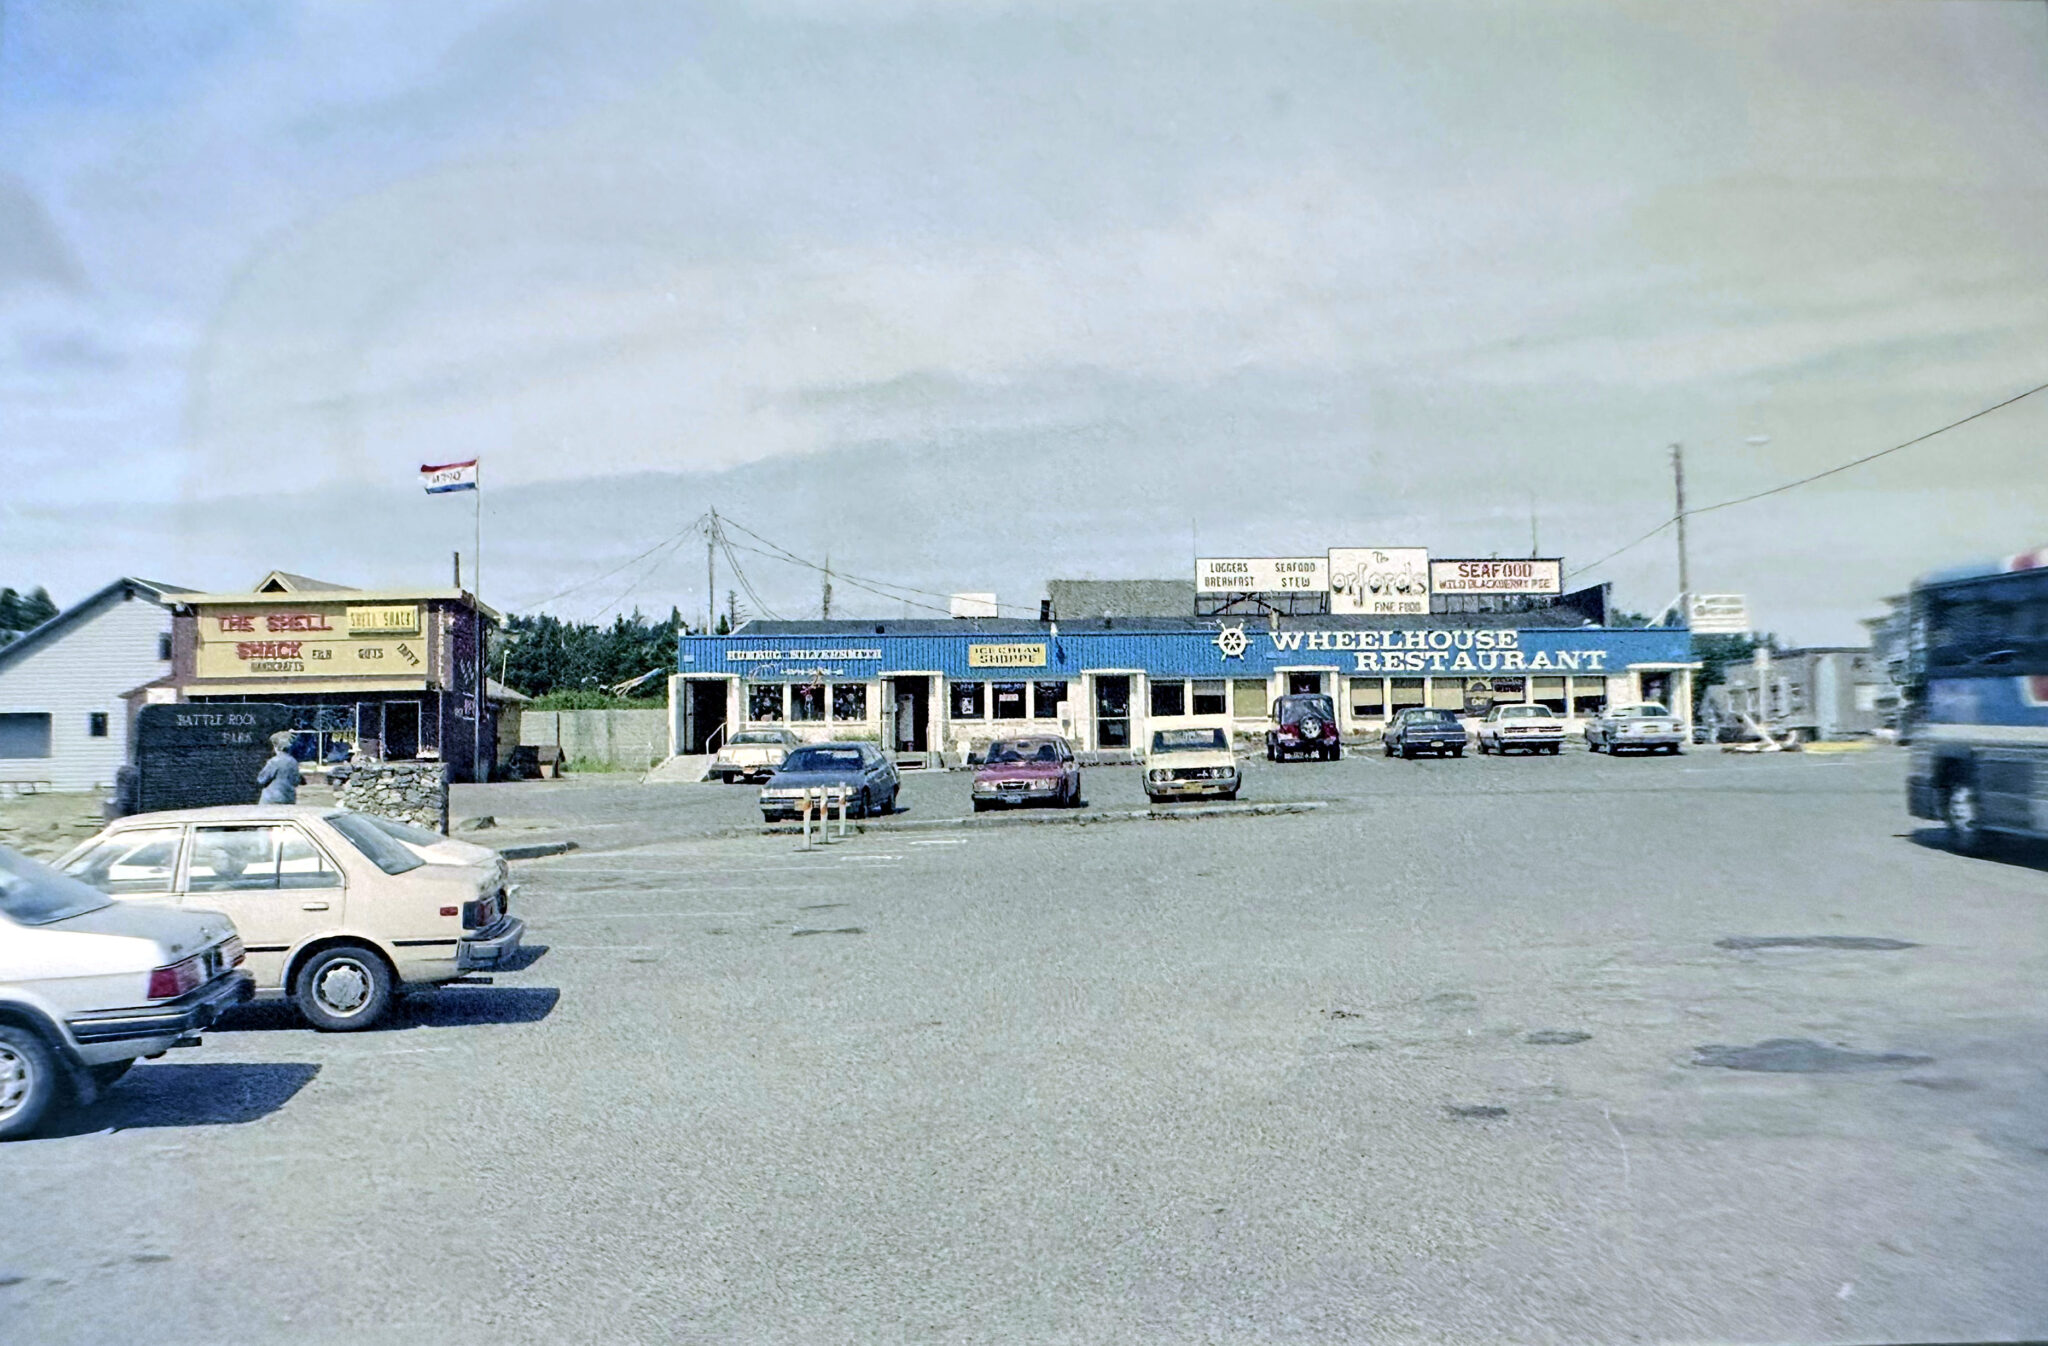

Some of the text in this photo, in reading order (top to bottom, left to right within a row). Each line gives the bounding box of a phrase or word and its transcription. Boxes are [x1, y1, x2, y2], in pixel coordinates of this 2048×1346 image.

[1210, 562, 1248, 573] LOGGERS
[1275, 562, 1316, 573] SEAFOOD
[1458, 563, 1533, 579] SEAFOOD
[1204, 576, 1256, 588] BREAKFAST
[1281, 577, 1310, 588] STEW
[1439, 579, 1466, 590] WILD
[1531, 578, 1552, 589] PIE
[1374, 601, 1422, 613] FINE FOOD
[219, 613, 333, 633] THE SHELL
[351, 611, 410, 627] SHELL SHACK
[1269, 630, 1519, 651] WHEELHOUSE
[236, 641, 304, 661] SHACK
[358, 648, 384, 659] GIFTS
[998, 646, 1041, 655] CREAM
[980, 655, 1036, 664] SHOPPE
[1354, 650, 1607, 672] RESTAURANT
[176, 713, 257, 727] BATTLE ROCK
